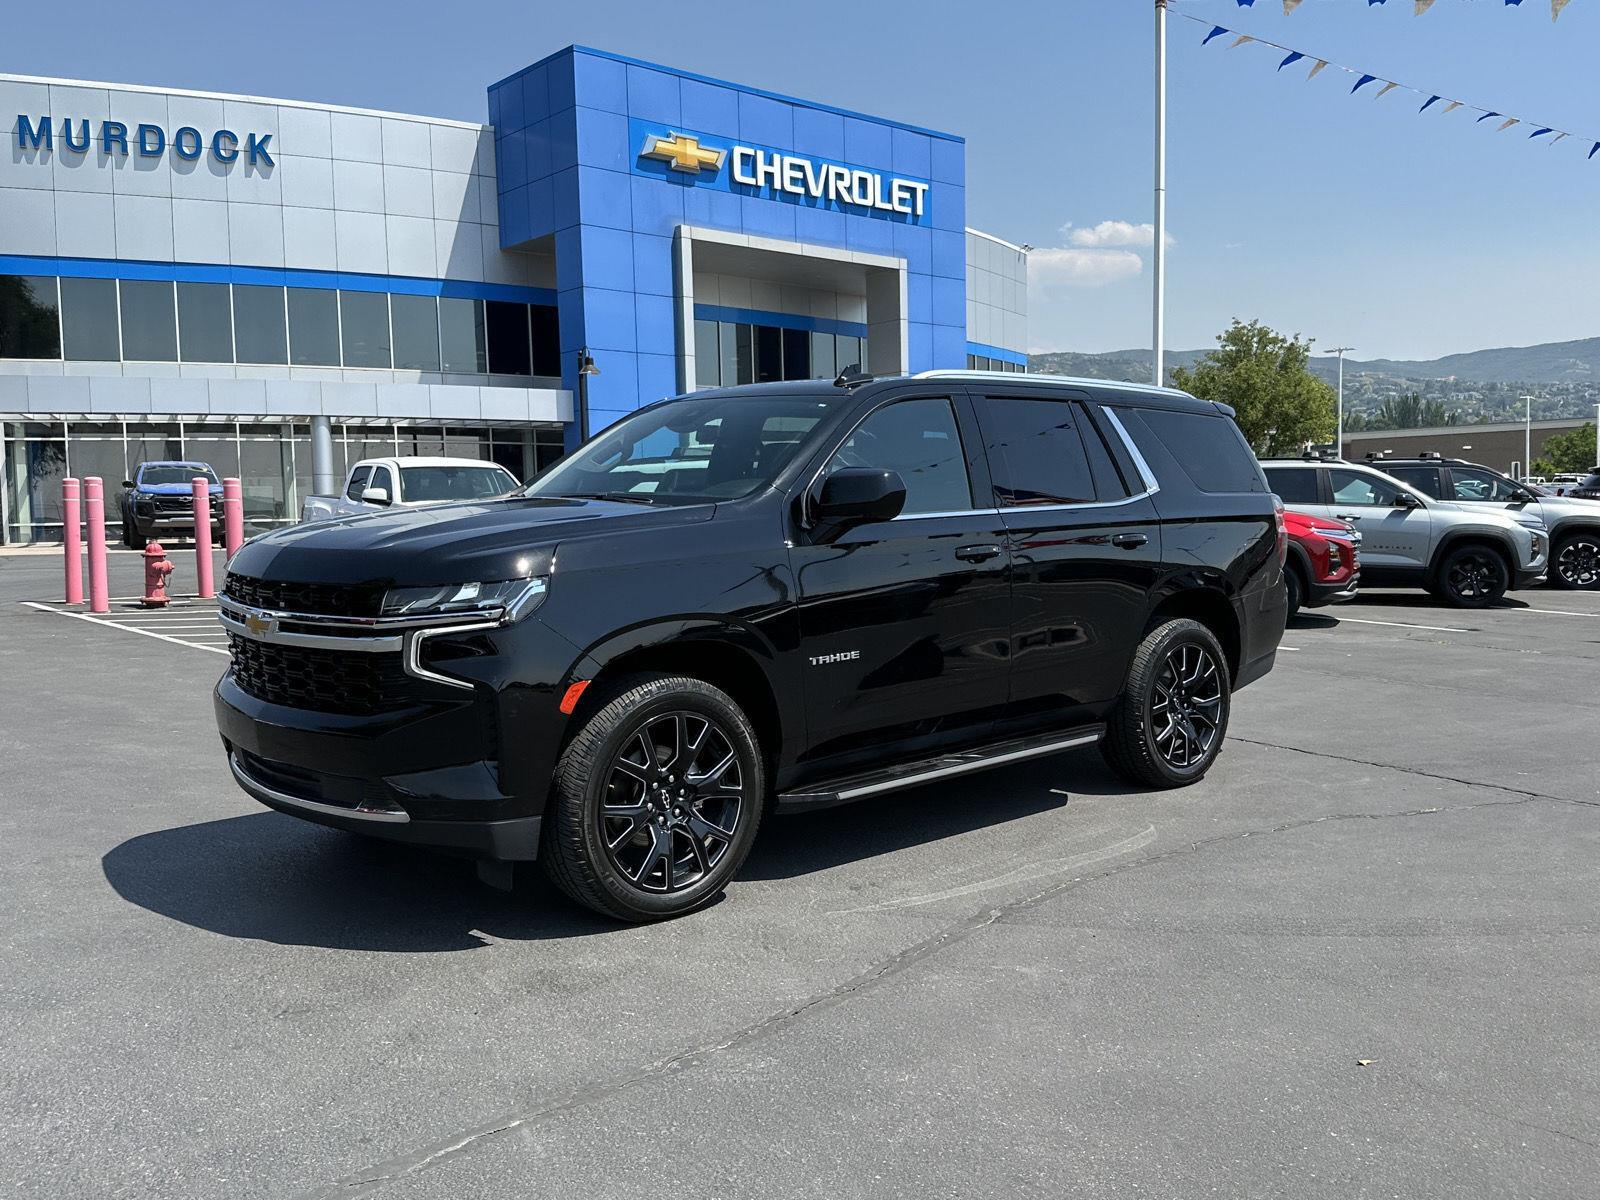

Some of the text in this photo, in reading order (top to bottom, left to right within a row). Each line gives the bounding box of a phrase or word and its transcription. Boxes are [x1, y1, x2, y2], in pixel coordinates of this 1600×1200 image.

[17, 114, 275, 167] MURDOCK
[732, 145, 929, 216] CHEVROLET
[809, 650, 860, 666] TAHOE
